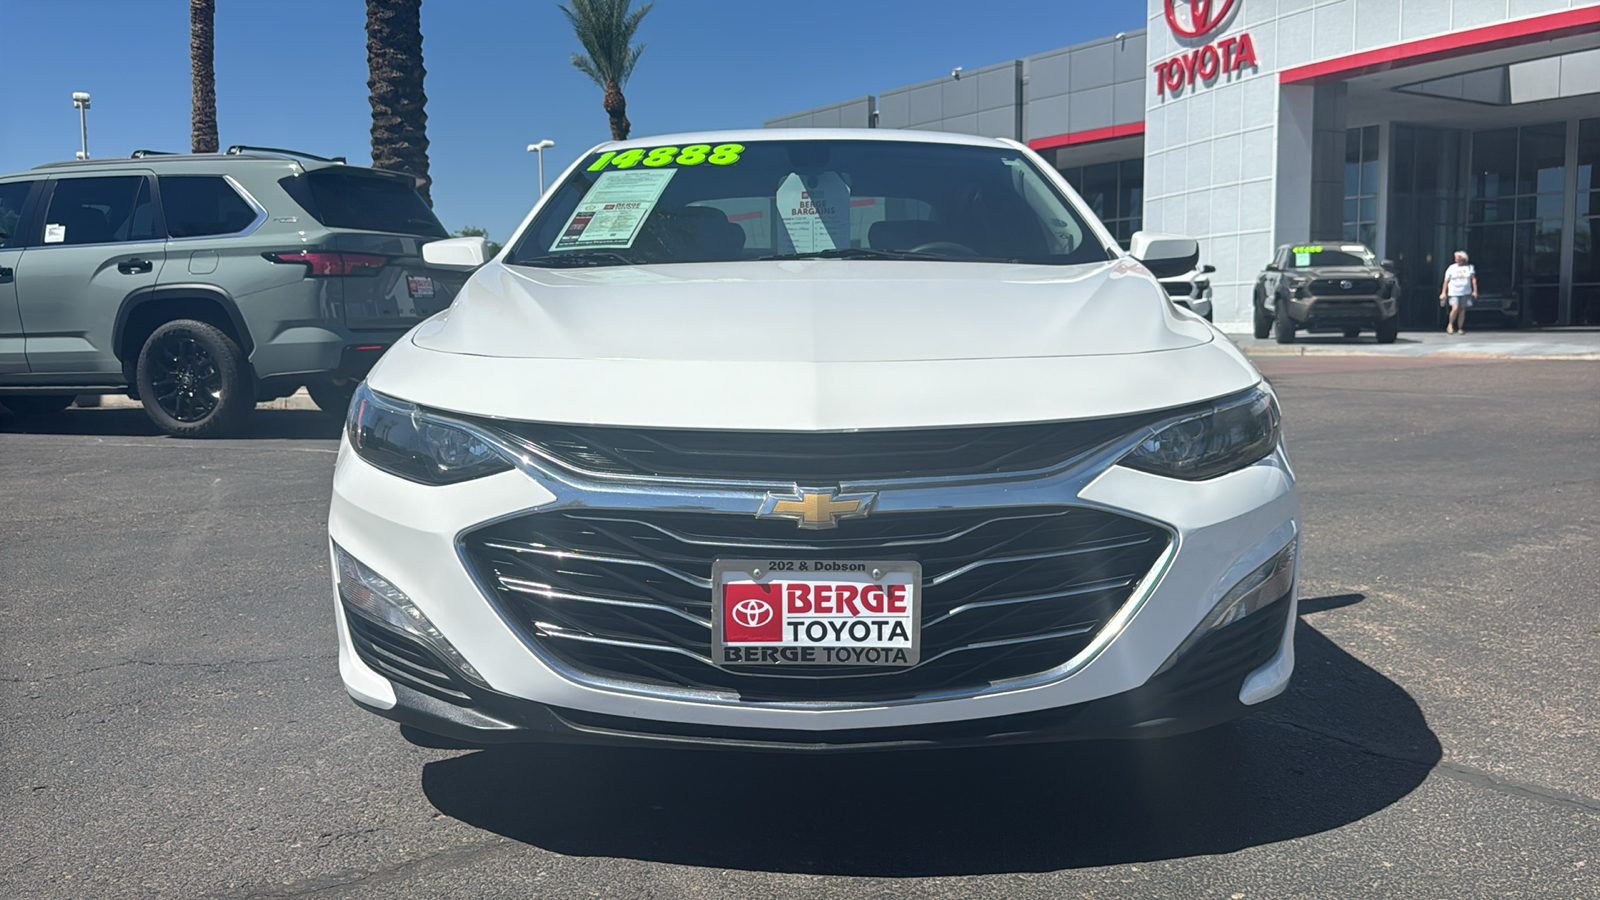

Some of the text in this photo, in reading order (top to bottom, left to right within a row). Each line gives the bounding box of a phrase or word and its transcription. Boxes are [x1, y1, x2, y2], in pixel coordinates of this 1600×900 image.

[1153, 33, 1257, 96] TOYOTA
[586, 143, 745, 172] 14888
[791, 207, 836, 216] BARGAINS
[799, 200, 827, 209] BERGE
[768, 561, 866, 571] 202 & Dobson
[786, 583, 908, 617] BERGE
[787, 620, 909, 643] TOYOTA
[724, 647, 908, 664] BERGE TOYOTA
